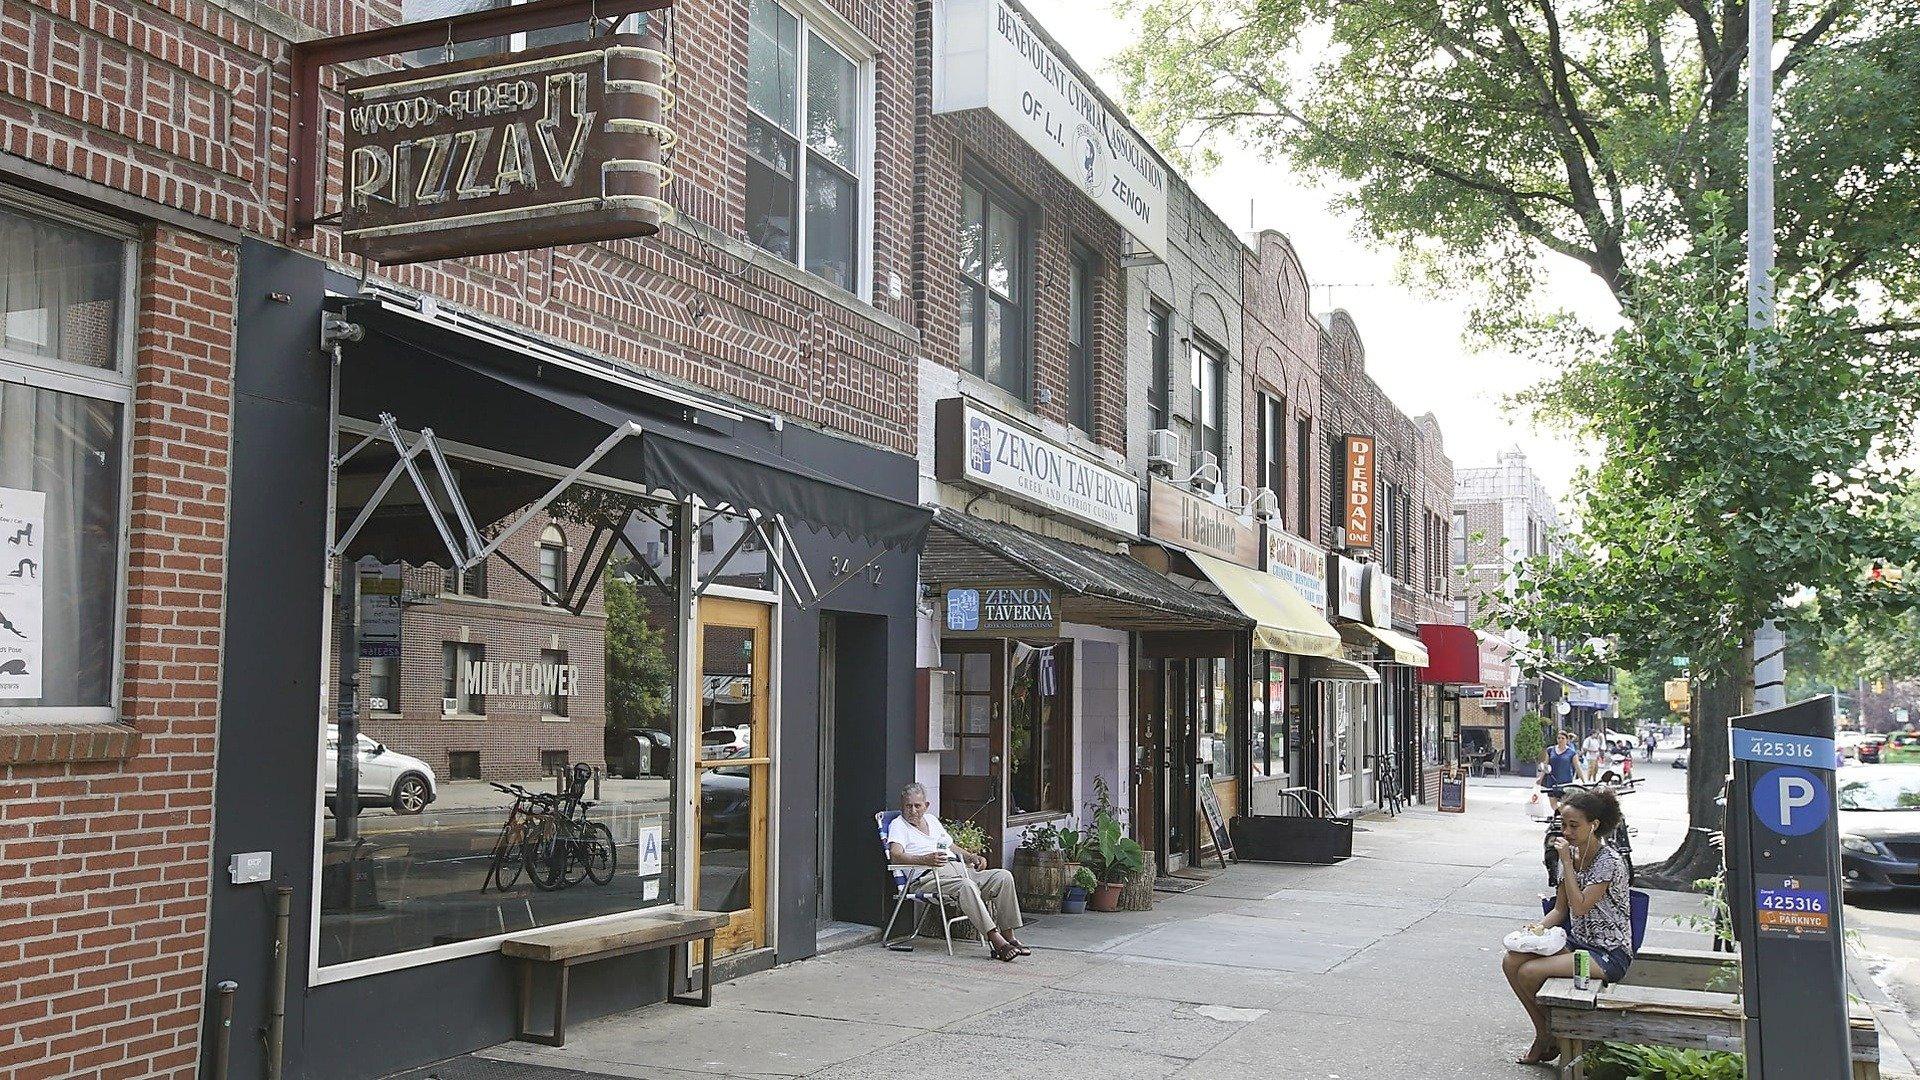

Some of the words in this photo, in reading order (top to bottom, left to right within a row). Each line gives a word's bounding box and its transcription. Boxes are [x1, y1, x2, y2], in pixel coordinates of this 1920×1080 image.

[350, 80, 538, 135] WOOD-FIRED
[997, 4, 1066, 97] BENEVOLENT
[1111, 124, 1162, 193] ASSOCIATION
[1022, 91, 1043, 121] OF
[1046, 112, 1065, 148] L.I.
[351, 120, 538, 213] PIZZA
[1112, 174, 1150, 224] ZENON
[996, 428, 1062, 488] ZENON
[1066, 459, 1134, 516] TAVERNA
[1351, 441, 1369, 532] DJERDAN
[1018, 475, 1043, 494] GREEK
[1046, 487, 1060, 501] AND
[1062, 493, 1092, 513] CYPRIOT
[1093, 505, 1118, 523] CUISINE
[1349, 533, 1369, 542] ONE
[831, 556, 850, 576] 34
[984, 588, 1053, 605] ZENON
[985, 604, 1053, 621] TAVERNA
[464, 660, 579, 696] MILKFLOWER
[1485, 690, 1509, 698] ATM
[1751, 742, 1813, 757] 425316
[1779, 776, 1815, 826] P
[643, 832, 658, 862] A
[1763, 896, 1822, 911] 425316
[1780, 915, 1822, 925] PARKNYC
